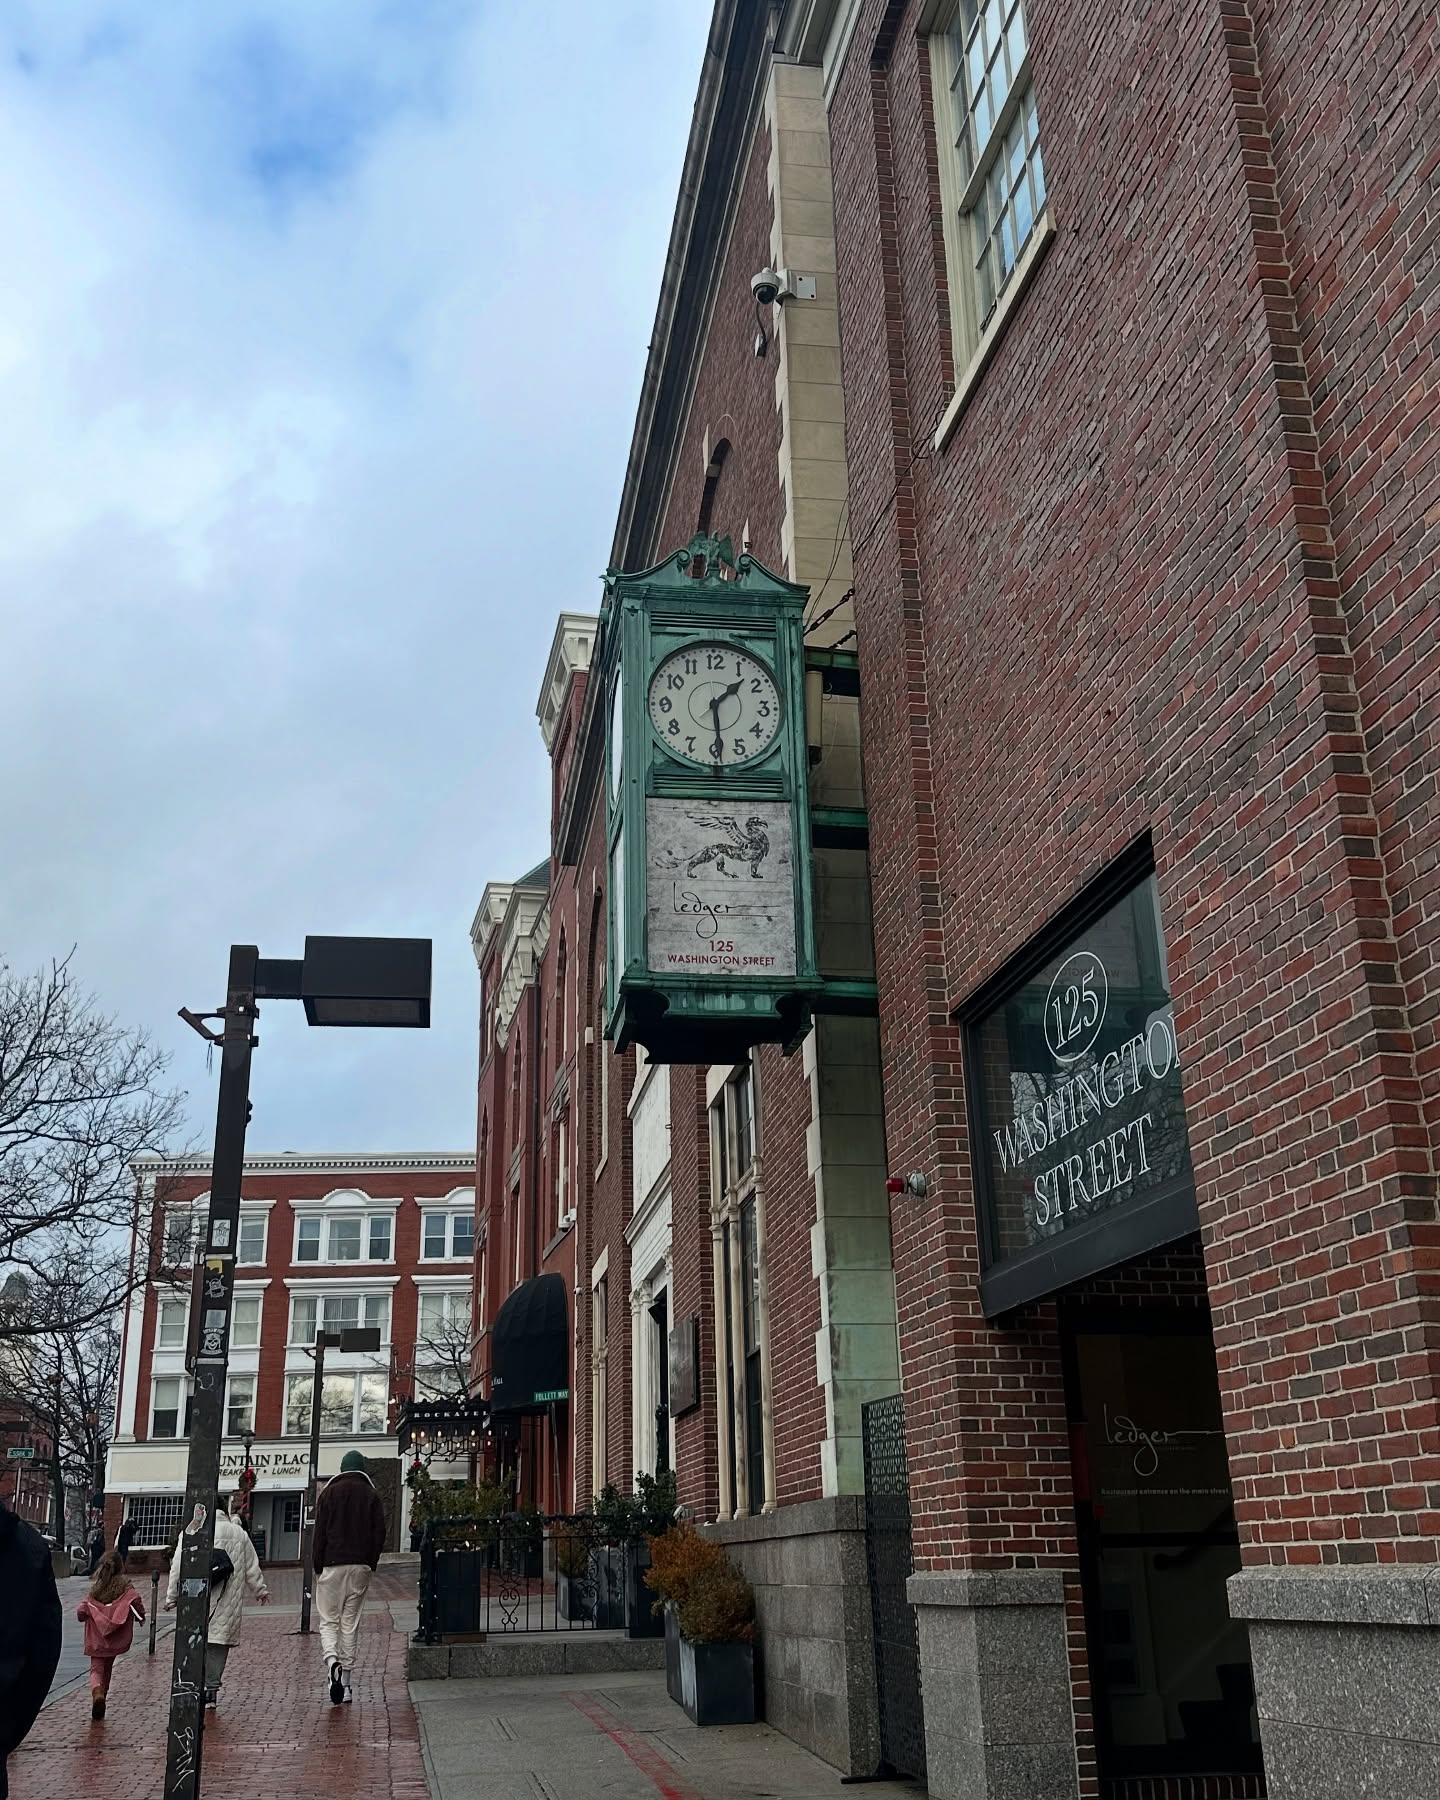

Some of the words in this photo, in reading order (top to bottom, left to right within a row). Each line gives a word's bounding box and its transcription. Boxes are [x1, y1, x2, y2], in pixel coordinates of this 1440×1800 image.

[685, 658, 698, 675] 11
[707, 654, 726, 670] 12
[736, 661, 742, 677] 1
[667, 673, 685, 690] 10
[751, 678, 763, 693] 2
[659, 696, 672, 713] 9
[757, 701, 770, 717] 3
[668, 718, 680, 736] 8
[749, 722, 763, 739] 4
[685, 735, 696, 753] 7
[733, 738, 746, 755] 5
[709, 940, 734, 952] 125
[667, 954, 740, 965] WASHINGTON
[743, 956, 775, 966] STREET
[1051, 966, 1099, 1050] 125
[1033, 1113, 1153, 1226] STREET
[535, 1391, 556, 1401] FOLLETT
[558, 1390, 568, 1399] WAY
[272, 1467, 301, 1475] LUNCH
[1179, 1487, 1191, 1495] the
